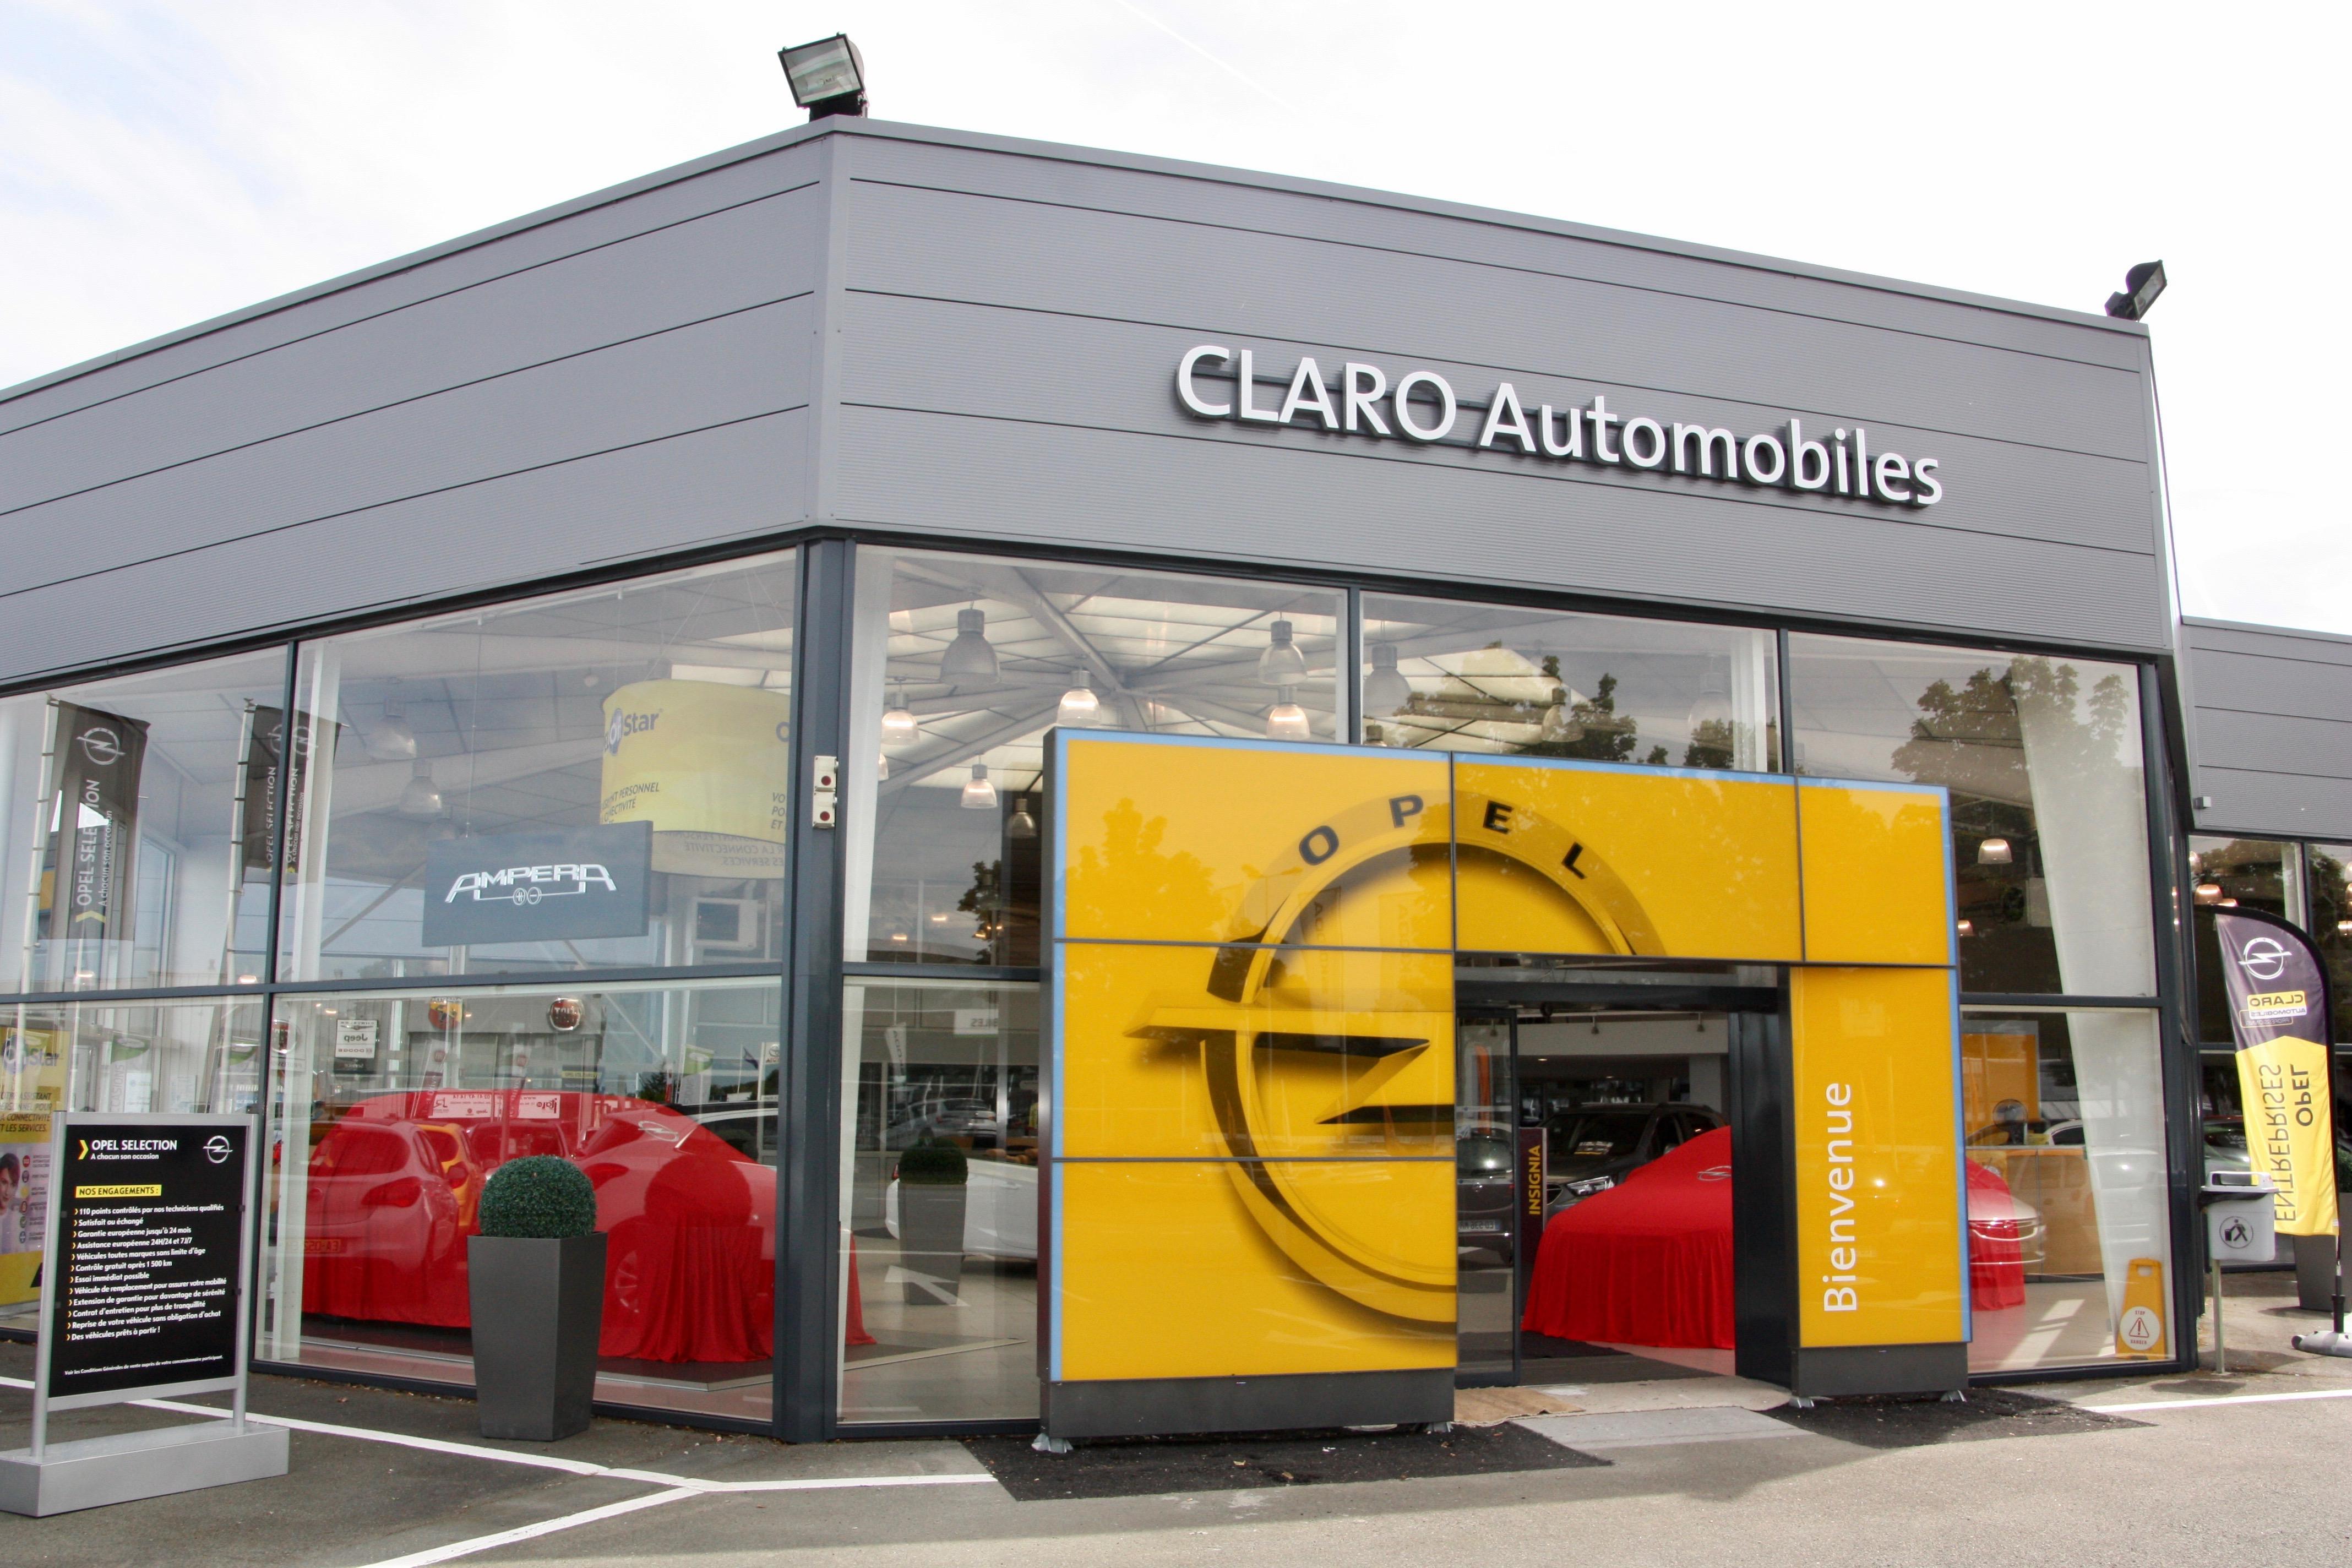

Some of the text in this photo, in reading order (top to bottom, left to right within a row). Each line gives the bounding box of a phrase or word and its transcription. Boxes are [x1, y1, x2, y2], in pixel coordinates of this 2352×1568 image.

[1176, 345, 1943, 506] CLARO Automobiles
[619, 782, 660, 799] PERSONNEL
[1299, 794, 1587, 880] OPEL
[103, 850, 111, 865] son
[77, 870, 94, 906] OPEL
[99, 865, 110, 897] chacun
[445, 864, 617, 903] AMPERA
[91, 1139, 177, 1151] OPEL SELECTION
[1528, 1145, 1541, 1215] INSIGNIA
[98, 1186, 155, 1195] ENGAGEMENTS
[1822, 1082, 1857, 1311] Bienvenue
[91, 1207, 112, 1216] points
[199, 1204, 224, 1212] qualifiés
[116, 1217, 144, 1226] échangé
[107, 1228, 145, 1237] européenne
[112, 1239, 150, 1248] européenne
[77, 1252, 107, 1260] Véhicules
[75, 1263, 104, 1271] Contrôle
[105, 1262, 127, 1272] gratuit
[127, 1261, 145, 1270] après
[92, 1273, 123, 1282] immédiat
[123, 1271, 150, 1282] possible
[74, 1286, 101, 1294] Véhicule
[110, 1283, 153, 1293] remplacement
[205, 1277, 227, 1286] mobilité
[73, 1298, 105, 1306] Extension
[116, 1295, 143, 1304] garantie
[202, 1288, 226, 1297] sérénité
[151, 1304, 164, 1313] plus
[173, 1300, 206, 1309] tranquillité
[72, 1321, 97, 1329] Reprise
[126, 1315, 152, 1324] véhicule
[167, 1313, 198, 1321] obligation
[85, 1330, 115, 1340] véhicules
[116, 1329, 132, 1338] prêts
[139, 1326, 157, 1336] partir
